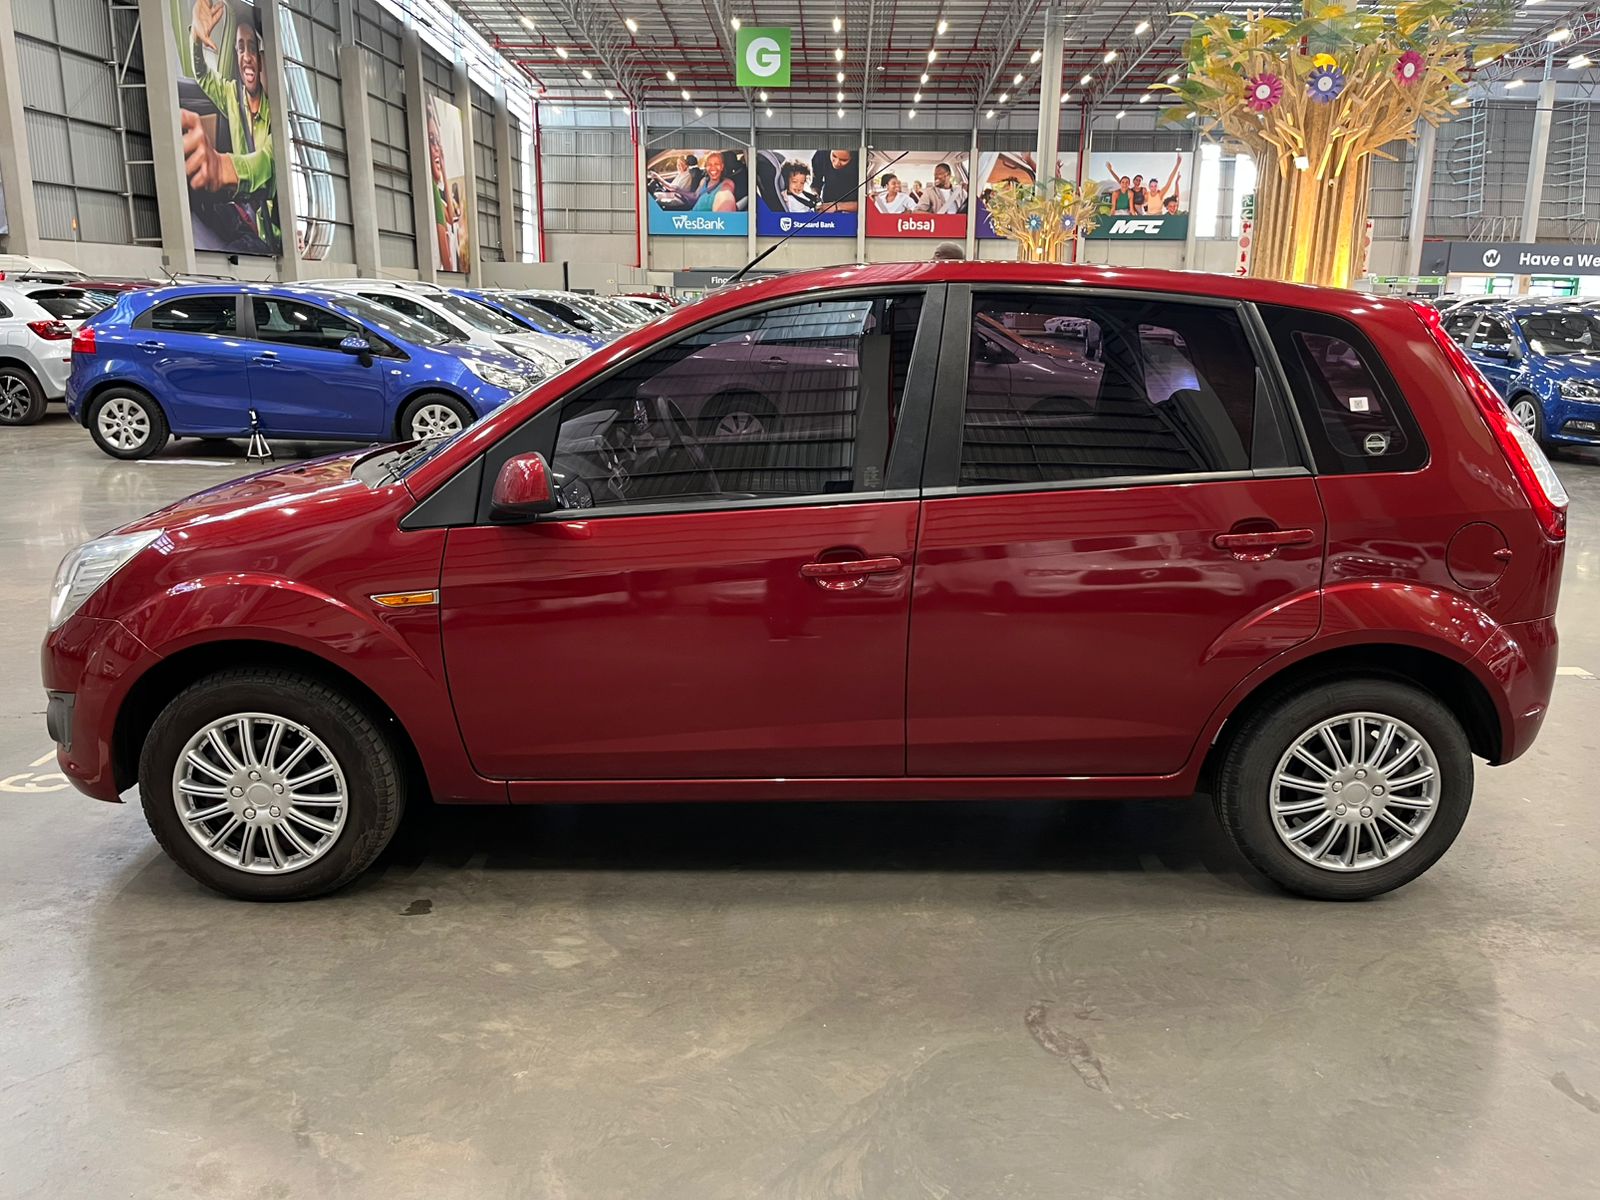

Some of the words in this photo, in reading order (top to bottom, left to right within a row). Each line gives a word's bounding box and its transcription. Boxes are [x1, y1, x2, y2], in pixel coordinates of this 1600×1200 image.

[745, 36, 781, 77] G
[672, 215, 725, 230] WesBank
[898, 217, 935, 233] (absa)
[1108, 220, 1165, 234] MFC
[1519, 252, 1560, 266] Have
[1563, 256, 1574, 267] a
